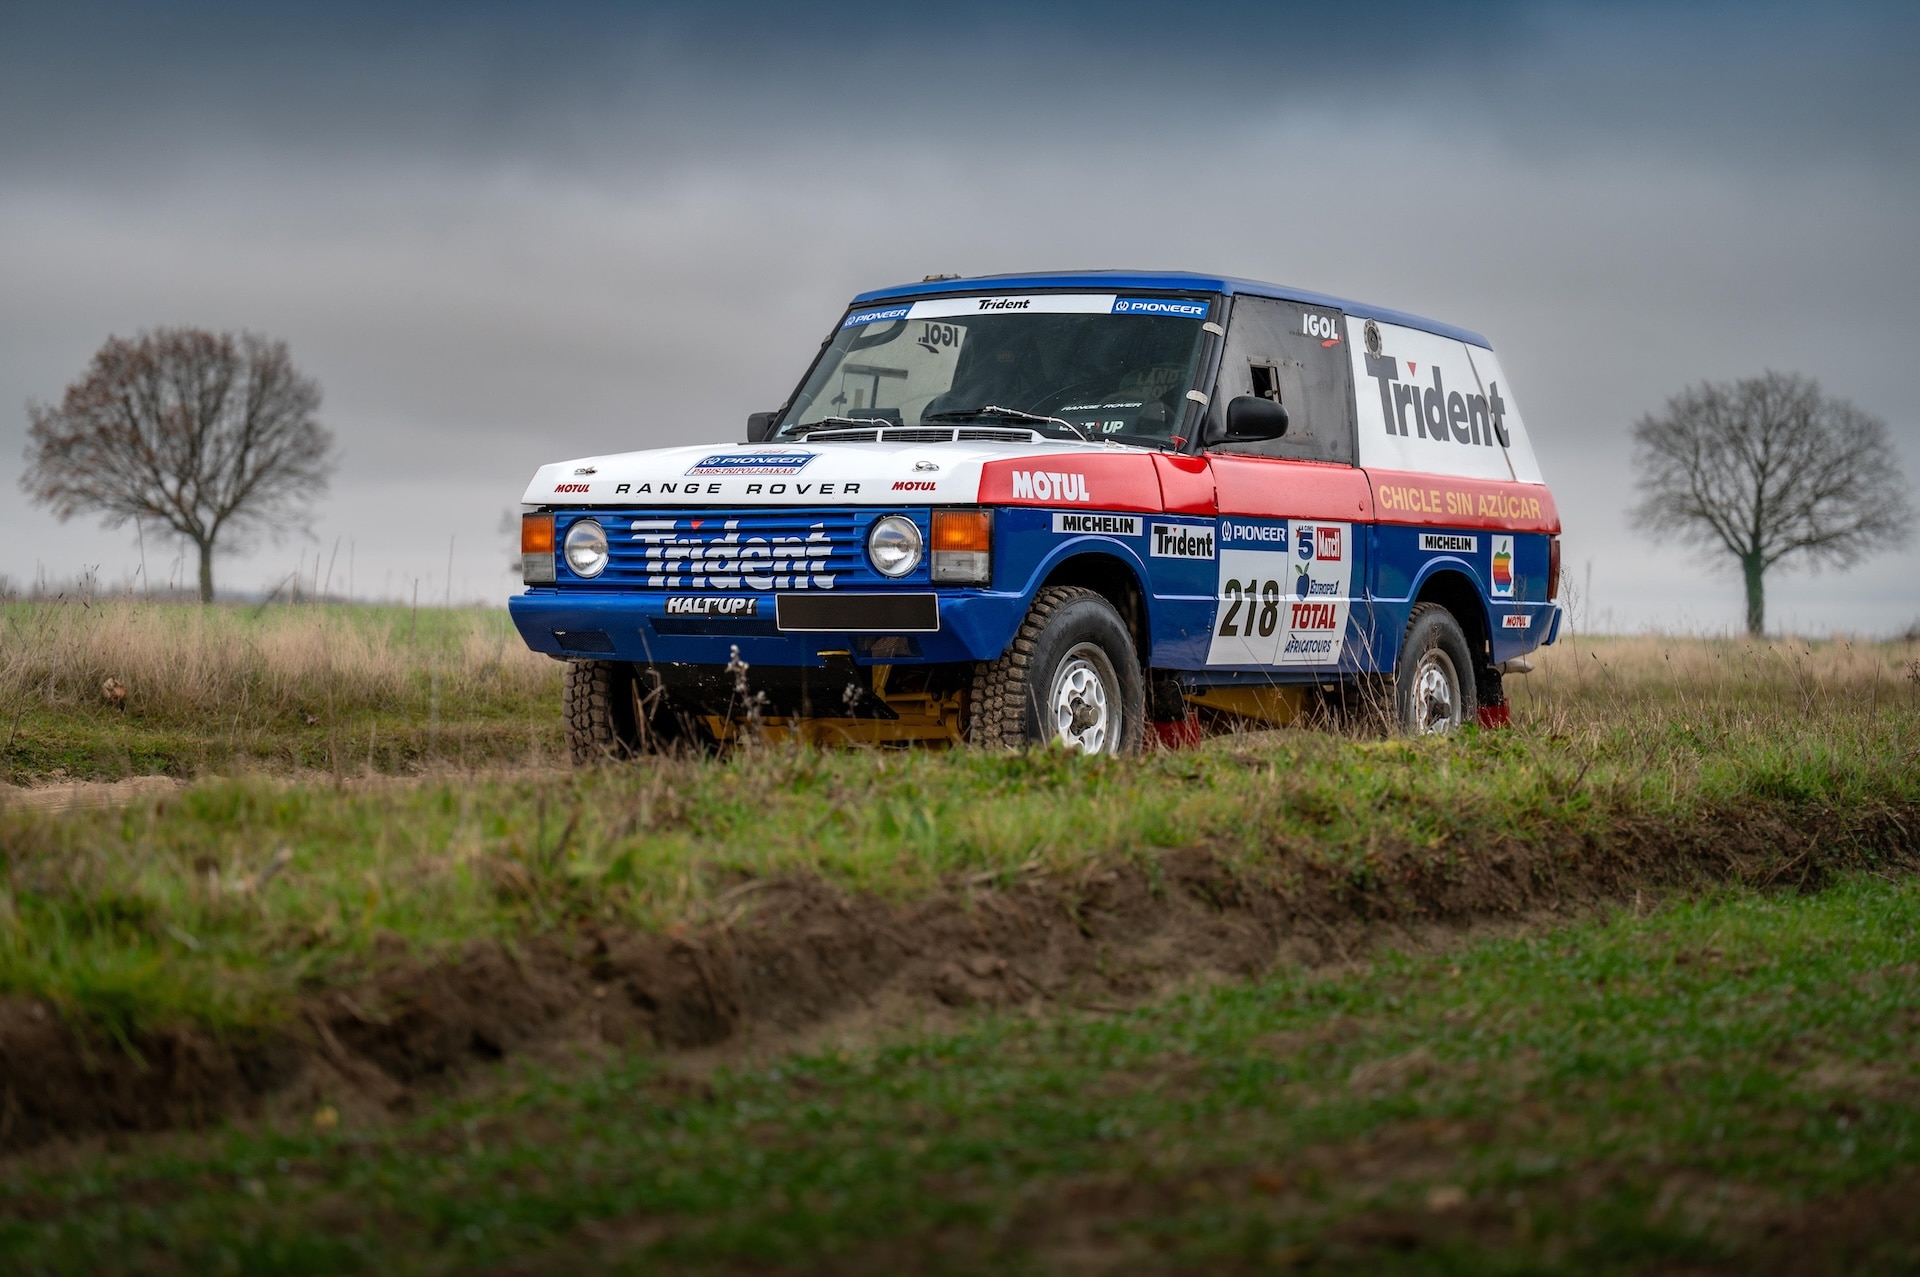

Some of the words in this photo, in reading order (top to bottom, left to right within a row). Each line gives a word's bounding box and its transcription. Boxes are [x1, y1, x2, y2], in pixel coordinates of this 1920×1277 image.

[978, 299, 1031, 310] Trident
[1131, 302, 1204, 315] PIONEER
[855, 309, 908, 323] PIONEER
[1303, 313, 1339, 340] IGOL
[1061, 404, 1101, 412] RANGE
[1364, 352, 1511, 448] Trident
[554, 484, 590, 493] MOTUL
[615, 483, 722, 494] RANGE
[746, 483, 861, 494] ROVER
[891, 481, 937, 491] MOTUL
[1012, 470, 1090, 502] MOTUL
[1379, 485, 1442, 514] CHICLE
[1446, 490, 1474, 516] SIN
[1478, 490, 1542, 520] AZÚCAR
[1063, 515, 1134, 534] MICHELIN
[1233, 525, 1286, 541] PIONEER
[1154, 525, 1213, 557] Trident
[1298, 532, 1314, 560] 5
[1425, 535, 1472, 551] MICHELIN
[631, 520, 836, 590] Trident
[1218, 578, 1280, 638] 218
[1291, 603, 1337, 629] TOTAL
[1506, 616, 1527, 627] MOTUL
